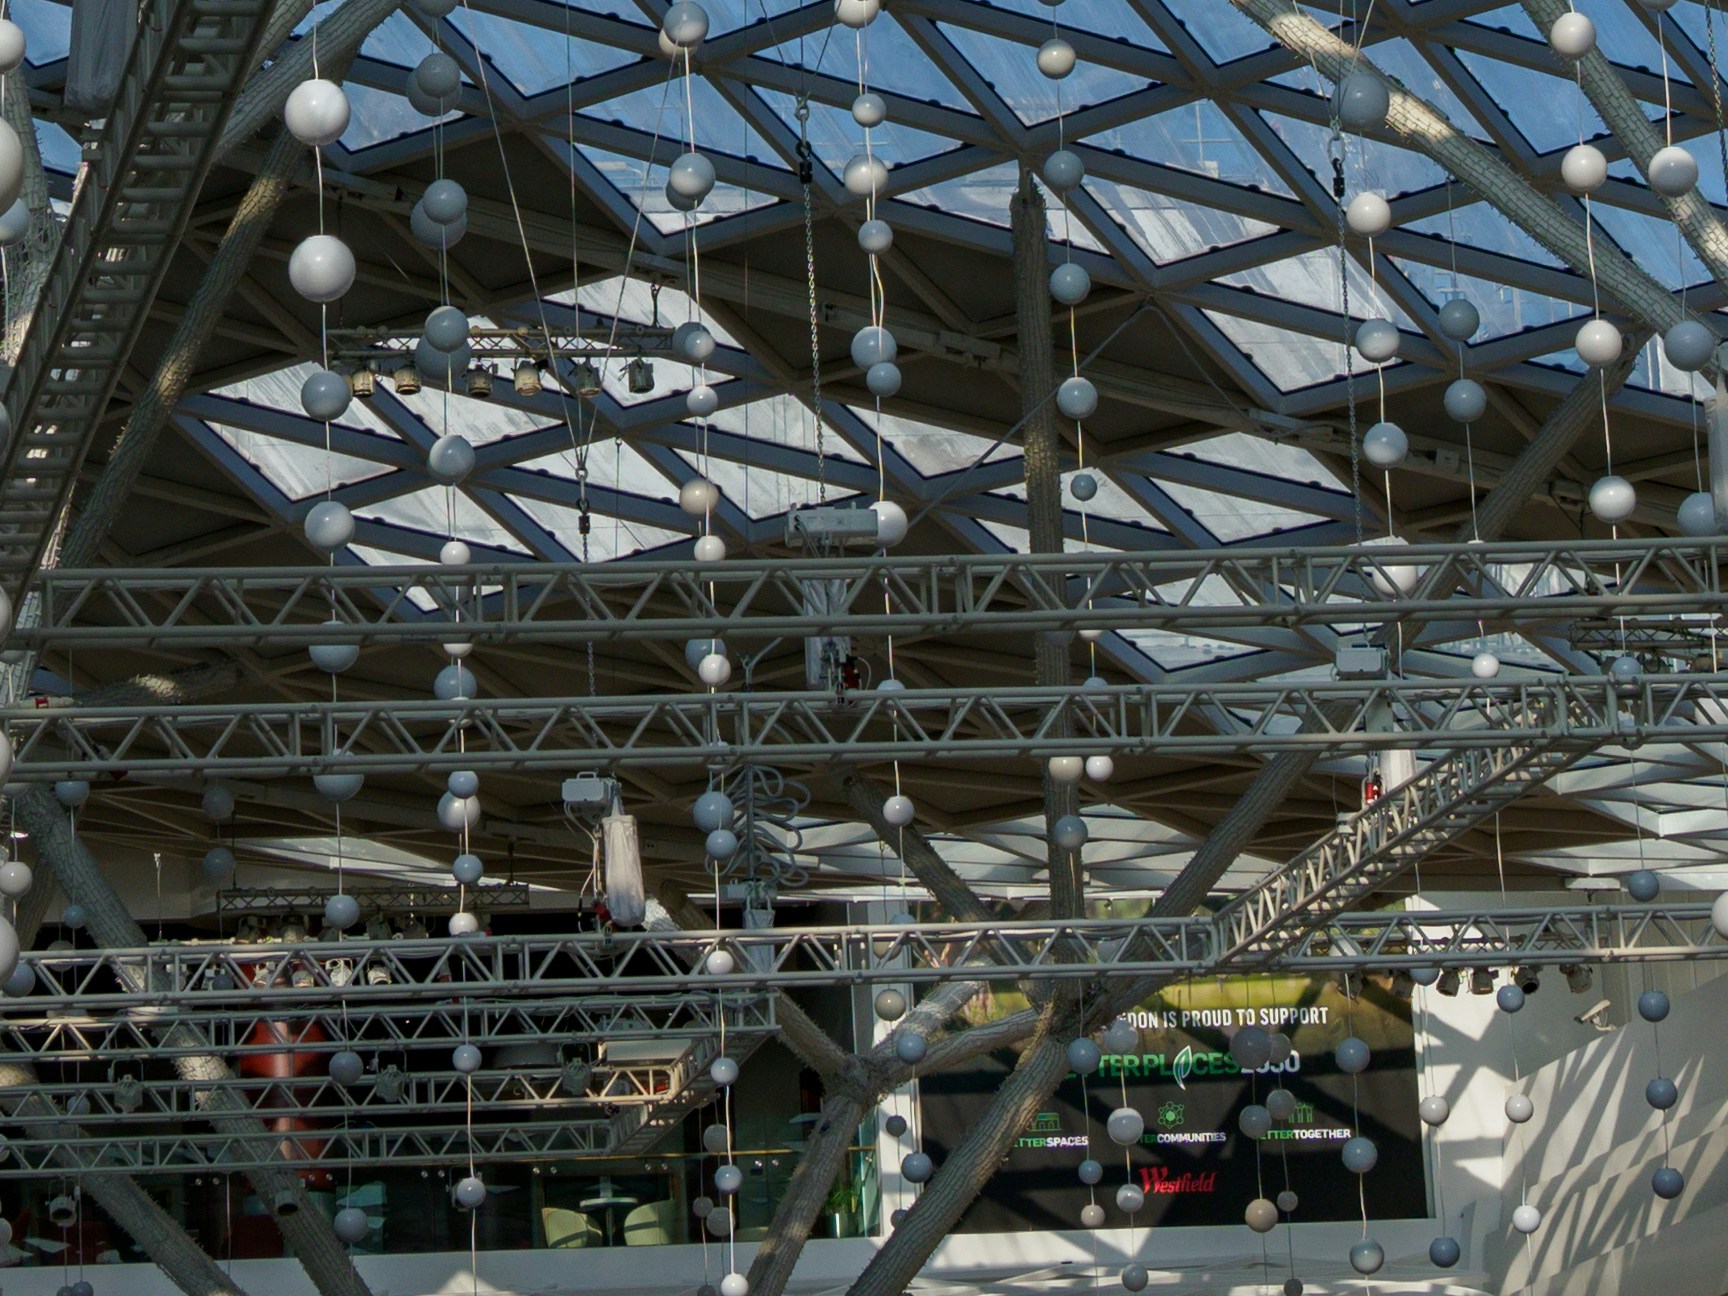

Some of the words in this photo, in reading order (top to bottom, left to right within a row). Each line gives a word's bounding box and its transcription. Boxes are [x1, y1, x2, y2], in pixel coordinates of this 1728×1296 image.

[1163, 1010, 1177, 1028] IS
[1181, 1008, 1232, 1028] PROUD
[1235, 1008, 1255, 1026] TO
[1259, 1006, 1329, 1026] SUPPORT
[1138, 1165, 1216, 1194] Westfield
